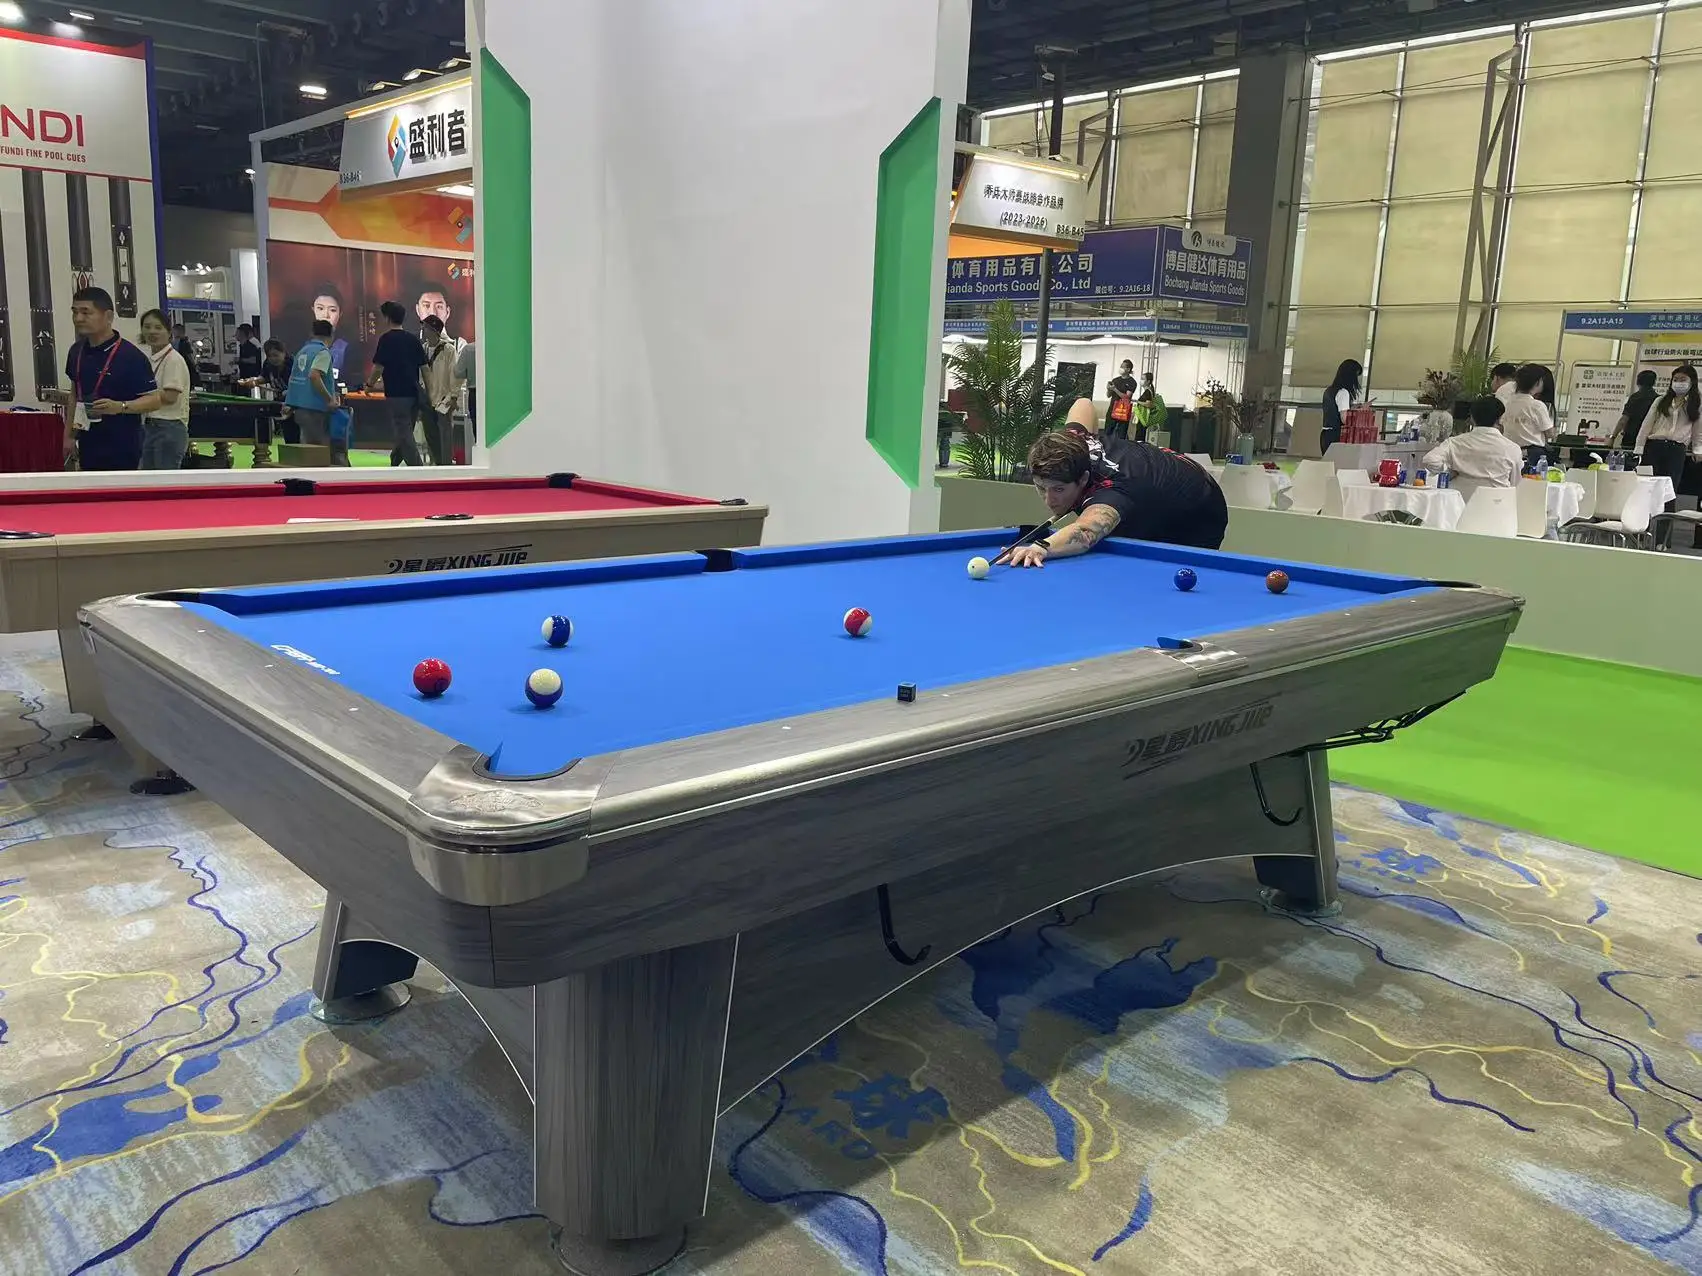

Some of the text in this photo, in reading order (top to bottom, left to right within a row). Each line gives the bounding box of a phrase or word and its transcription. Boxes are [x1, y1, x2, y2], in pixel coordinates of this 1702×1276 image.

[409, 109, 466, 160] 盛利者
[1, 146, 86, 163] FUNDI FINE POOL CUES
[1001, 212, 1048, 227] (2023-2026)
[1056, 224, 1085, 237] B36-B45
[952, 253, 1093, 279] 体育用品有公司
[1165, 249, 1246, 280] 博昌健达体育用品
[976, 281, 1008, 294] Sports
[1011, 279, 1041, 291] Good
[1072, 277, 1091, 289] Ltd
[1165, 274, 1245, 296] Bochang Jianda Sports Goods
[1581, 317, 1624, 325] 9.2A13-A15
